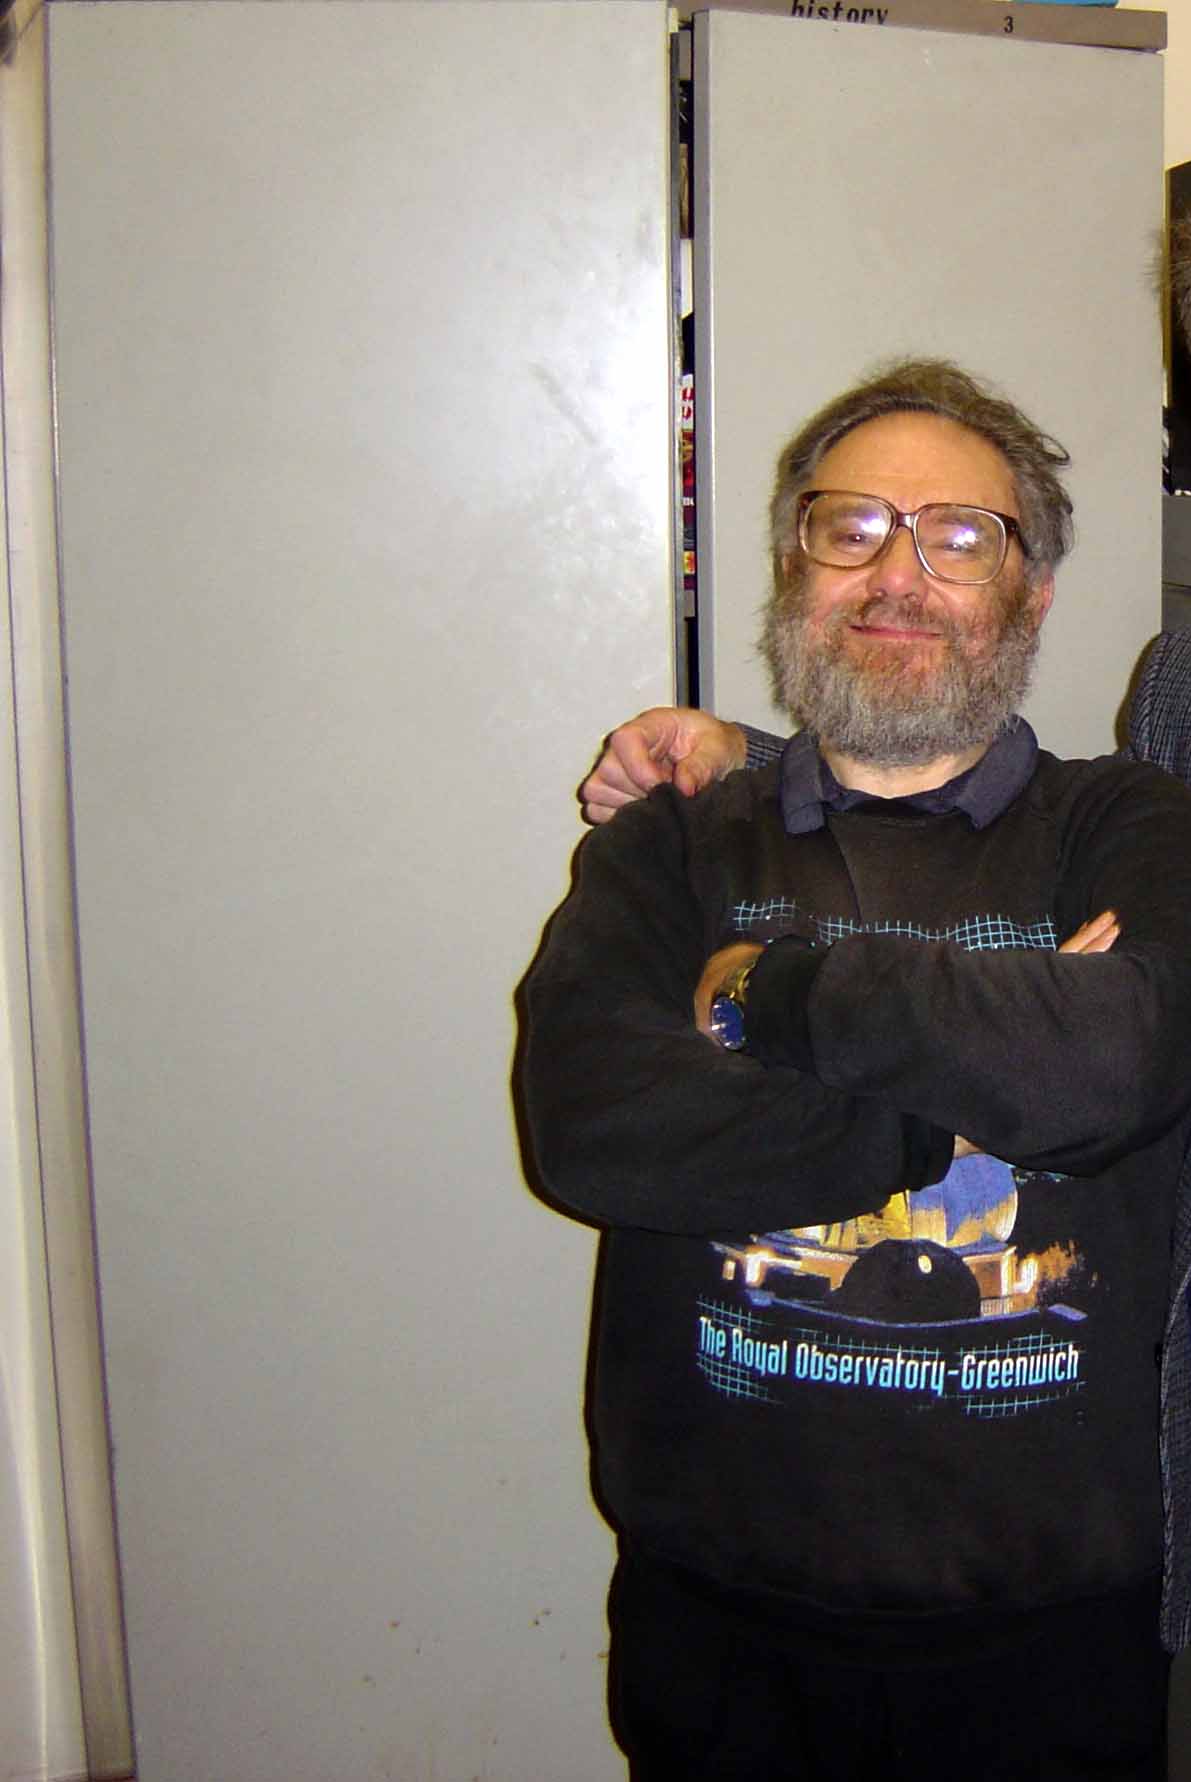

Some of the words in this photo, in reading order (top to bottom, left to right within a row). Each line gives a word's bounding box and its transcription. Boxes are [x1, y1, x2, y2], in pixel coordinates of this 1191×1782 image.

[791, 0, 889, 24] history
[1003, 15, 1014, 33] 3
[699, 1316, 726, 1358] The
[731, 1327, 788, 1376] Royal
